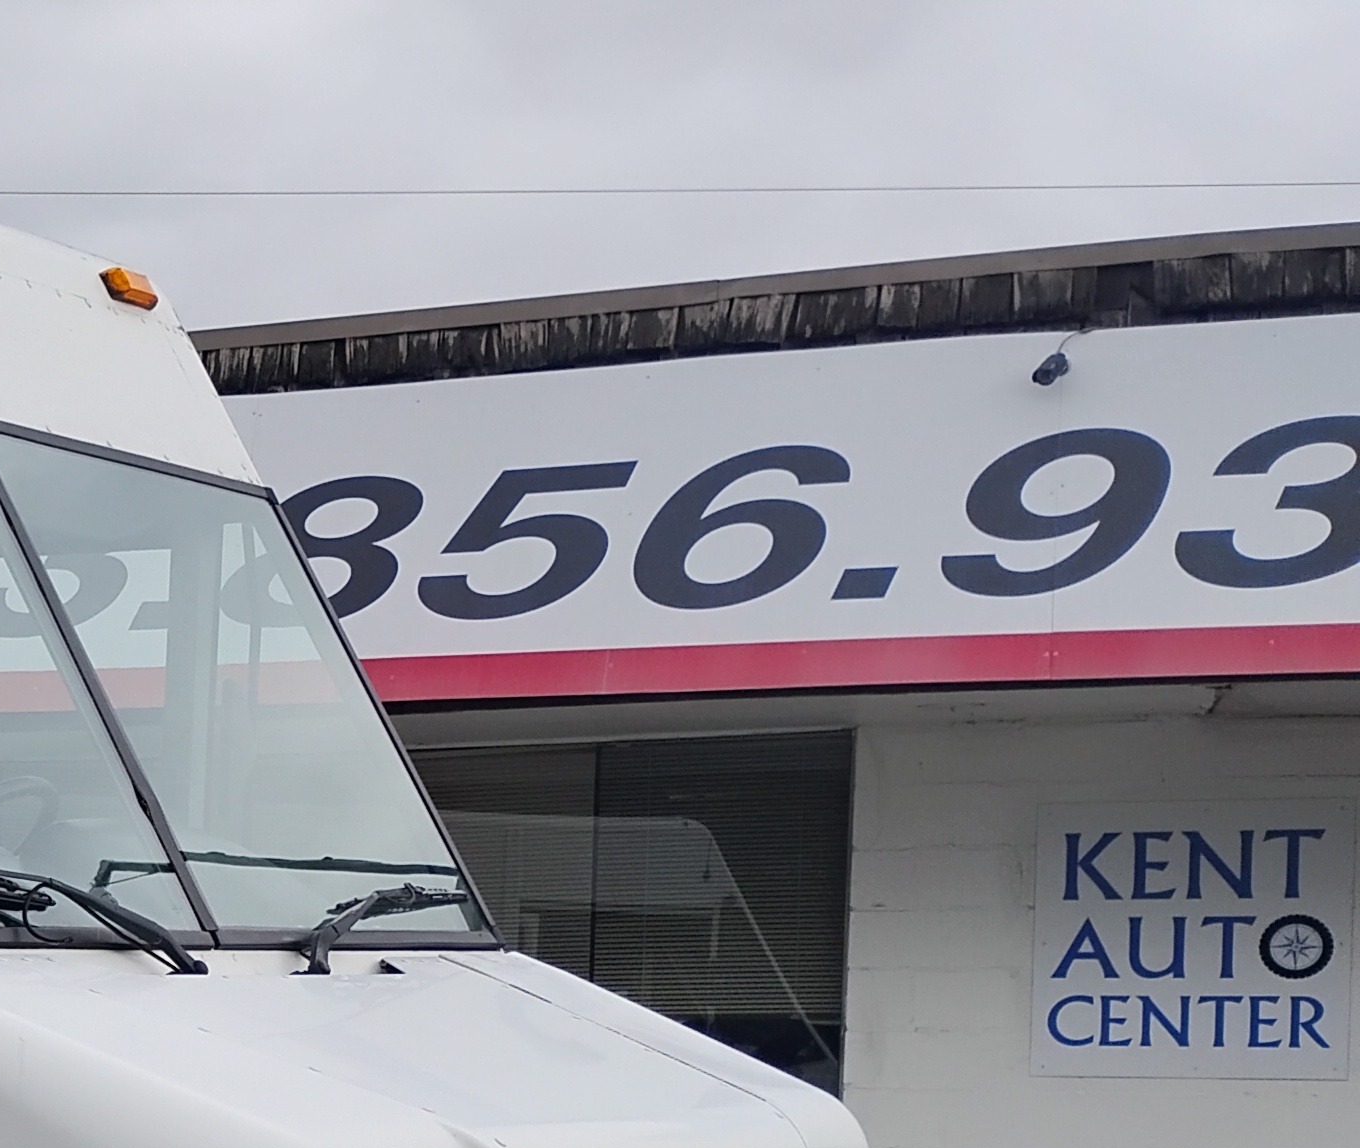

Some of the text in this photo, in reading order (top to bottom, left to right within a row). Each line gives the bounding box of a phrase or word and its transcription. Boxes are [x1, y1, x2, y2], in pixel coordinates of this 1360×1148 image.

[1062, 828, 1327, 901] KENT
[1049, 913, 1335, 980] AUTO
[1046, 994, 1332, 1049] CENTER
